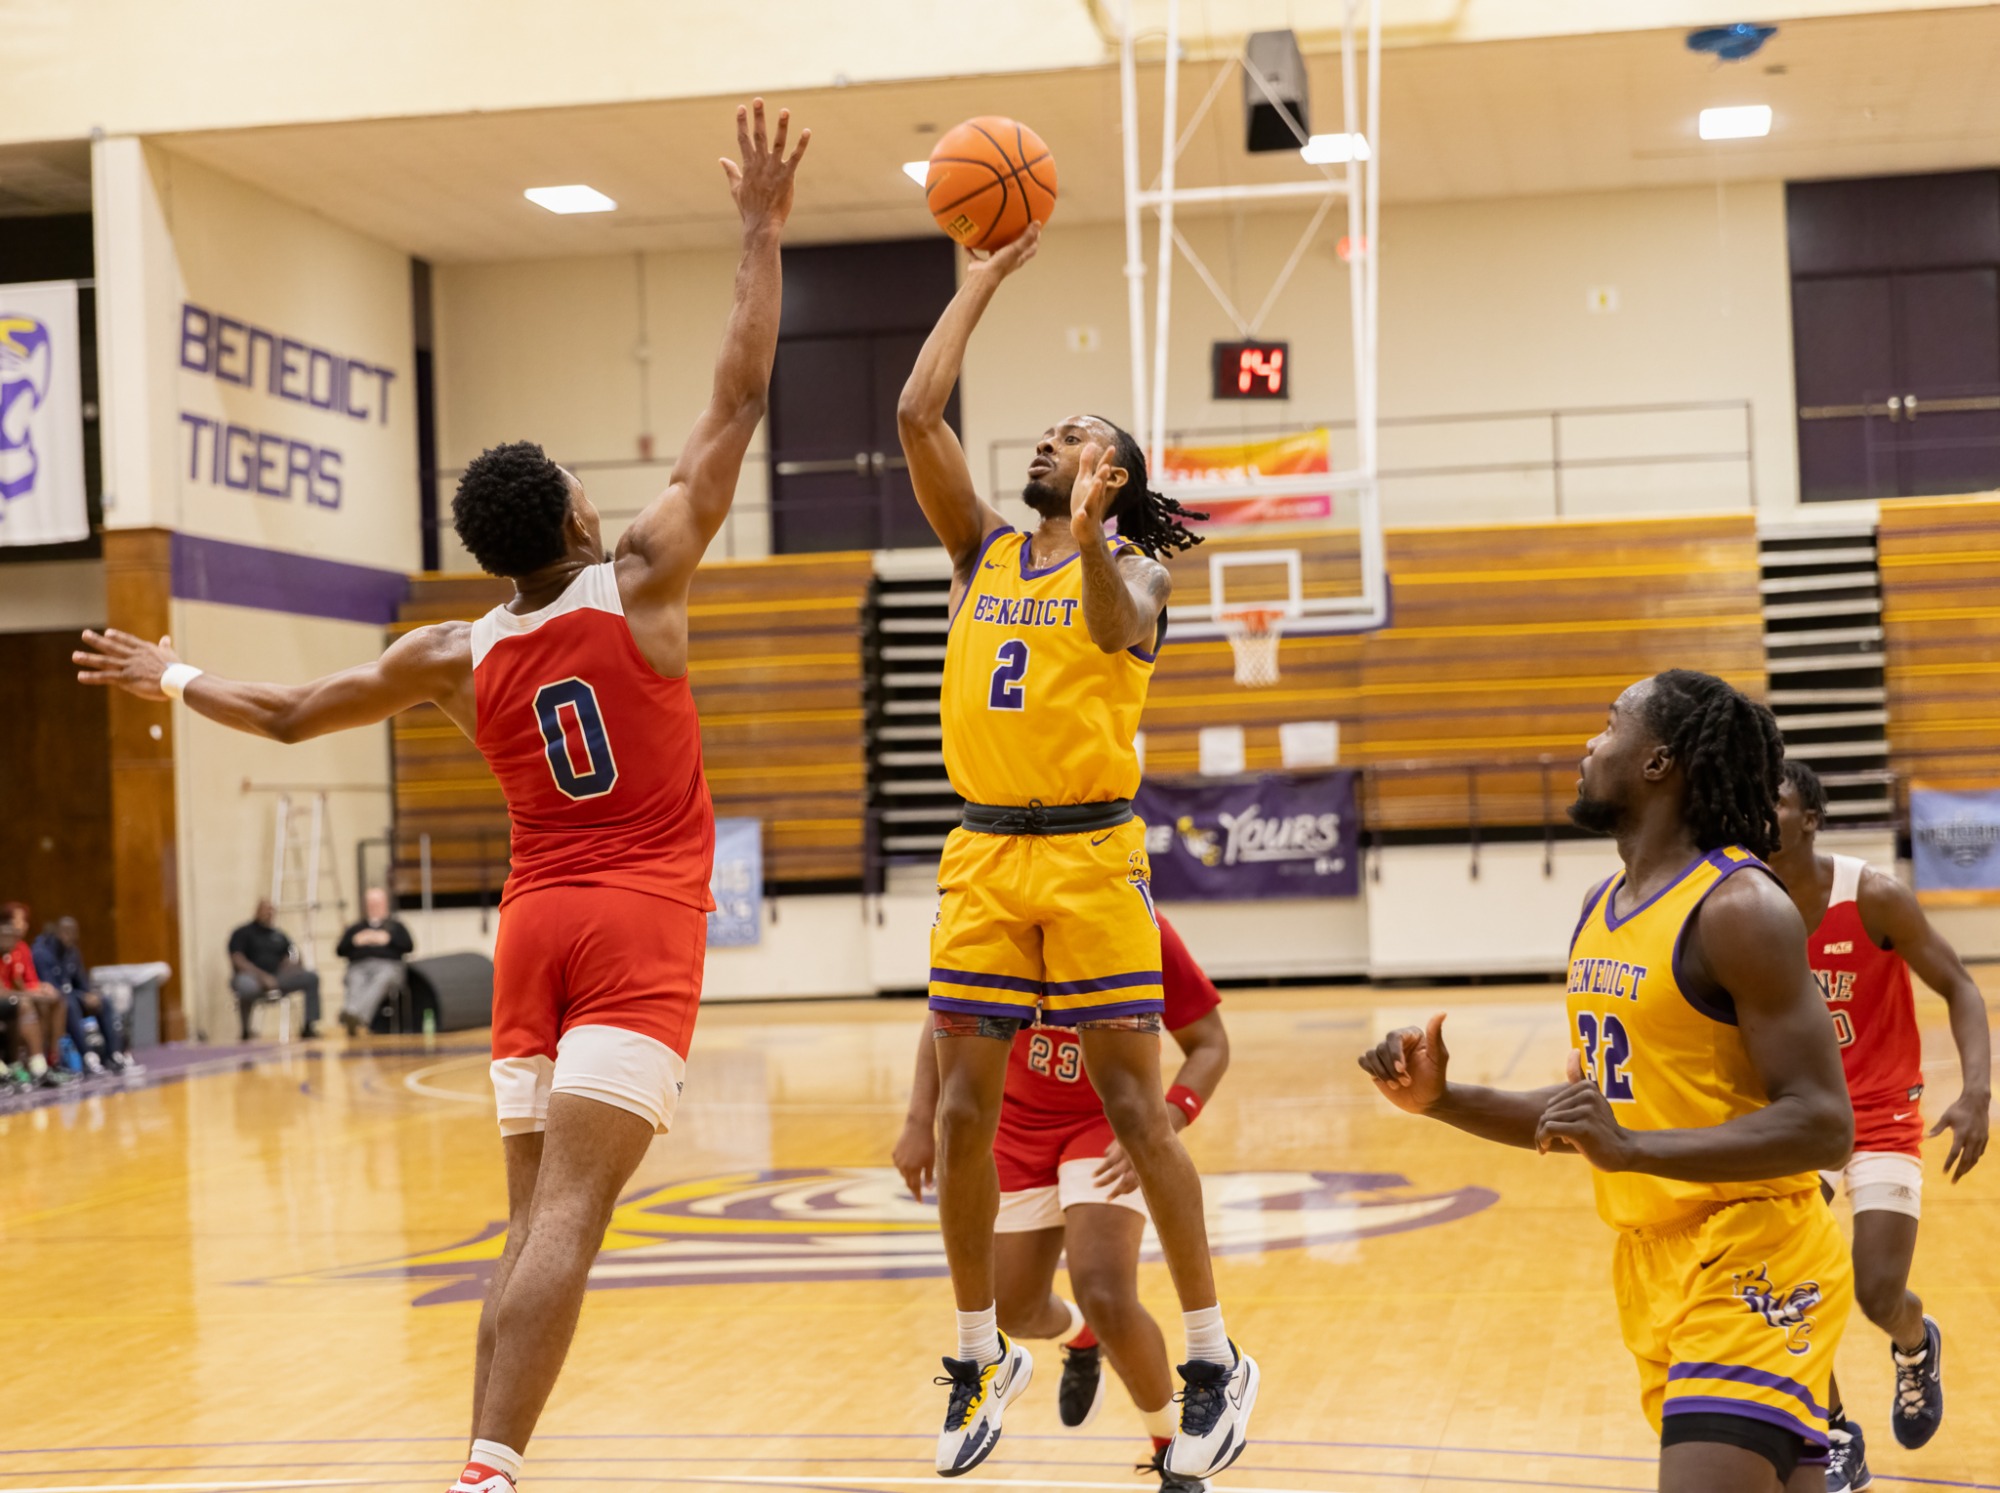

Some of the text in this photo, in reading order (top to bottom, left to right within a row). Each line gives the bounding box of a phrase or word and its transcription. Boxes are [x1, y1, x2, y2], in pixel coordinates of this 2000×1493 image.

[181, 302, 396, 425] BENEDICT
[1238, 348, 1283, 394] 14
[181, 412, 342, 510] TIGERS
[973, 593, 1079, 627] BENEDICT
[987, 638, 1031, 712] 2
[532, 676, 619, 801] 0
[1028, 1033, 1082, 1084] 23
[1576, 1010, 1637, 1104] 32
